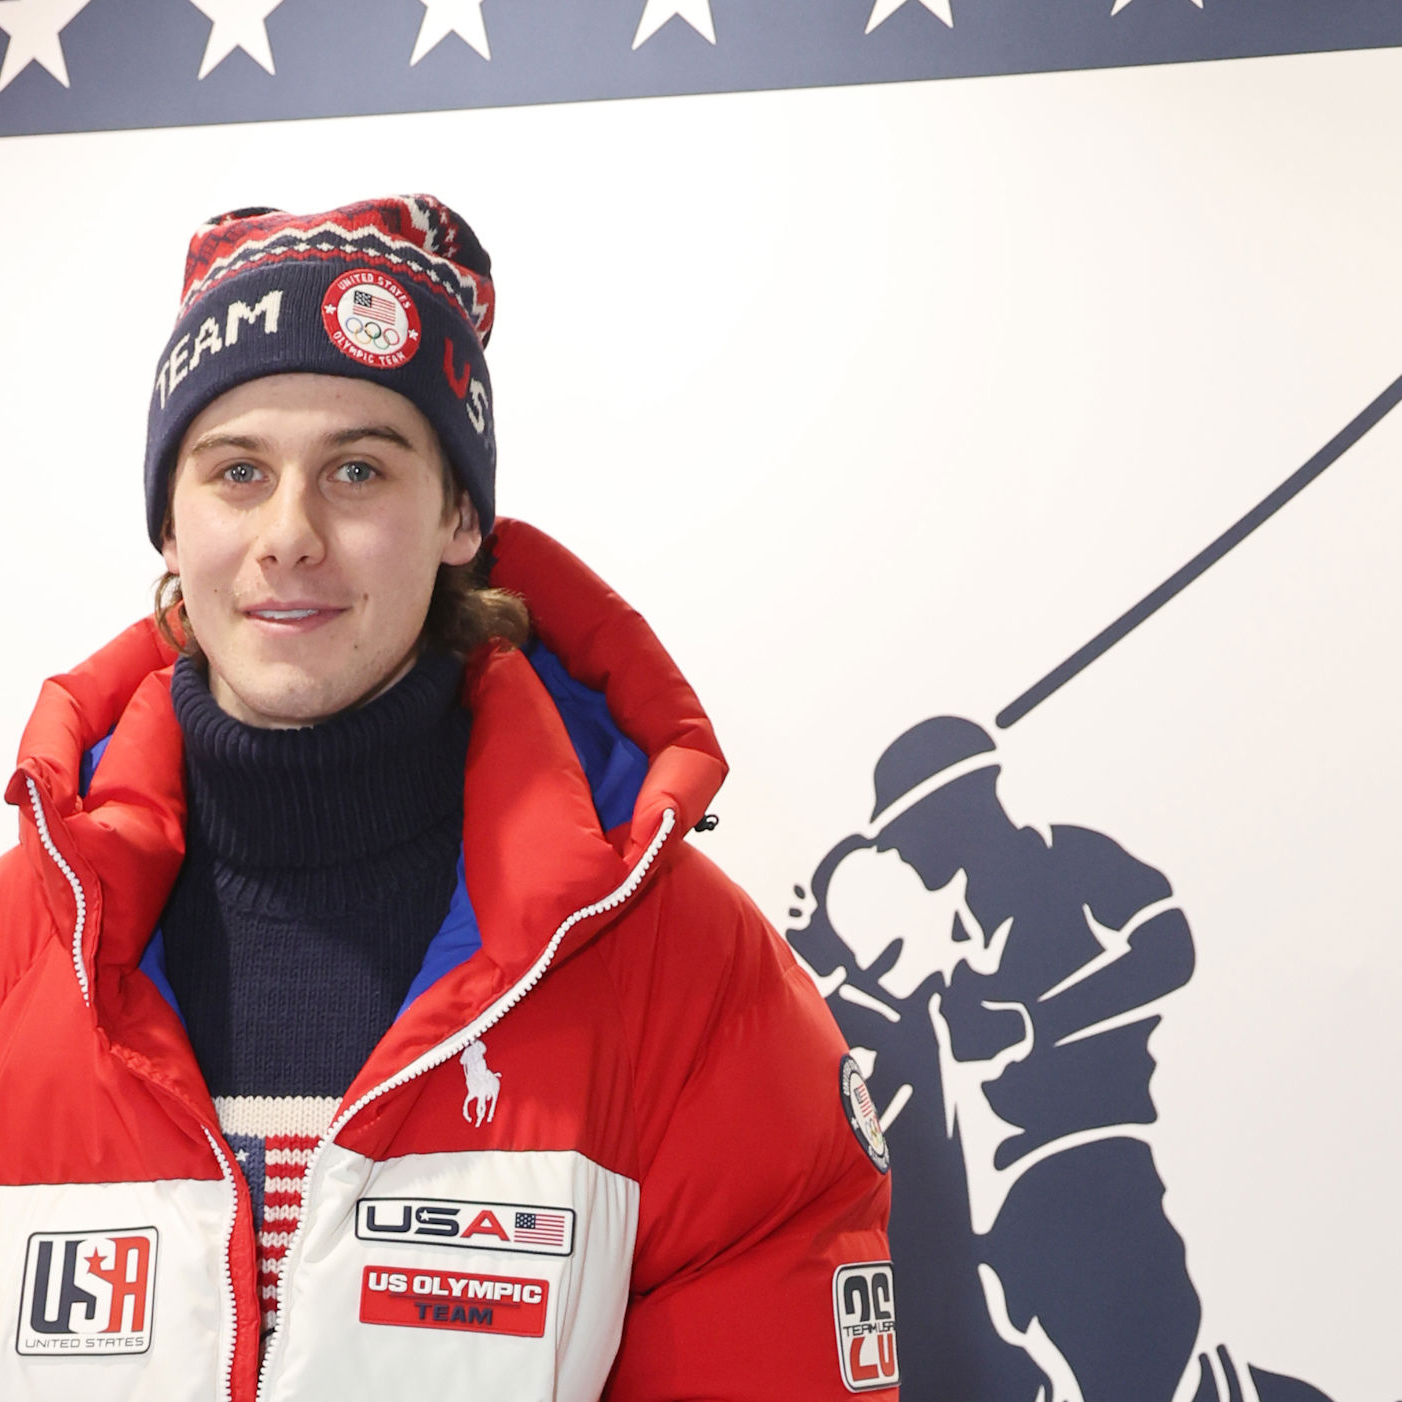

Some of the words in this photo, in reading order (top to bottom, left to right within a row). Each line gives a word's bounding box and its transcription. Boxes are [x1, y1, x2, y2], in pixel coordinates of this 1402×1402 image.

[337, 273, 374, 291] UNITED
[378, 276, 411, 309] STATES
[155, 289, 284, 410] TEAM
[333, 330, 374, 363] OLYMPIC
[379, 351, 406, 366] TEAM
[366, 1204, 511, 1242] USA
[30, 1235, 151, 1334] USA
[368, 1271, 407, 1293] US
[412, 1274, 542, 1305] OLYMPIC
[414, 1301, 493, 1326] TEAM
[25, 1338, 81, 1349] UNITED
[85, 1336, 145, 1348] STATES
